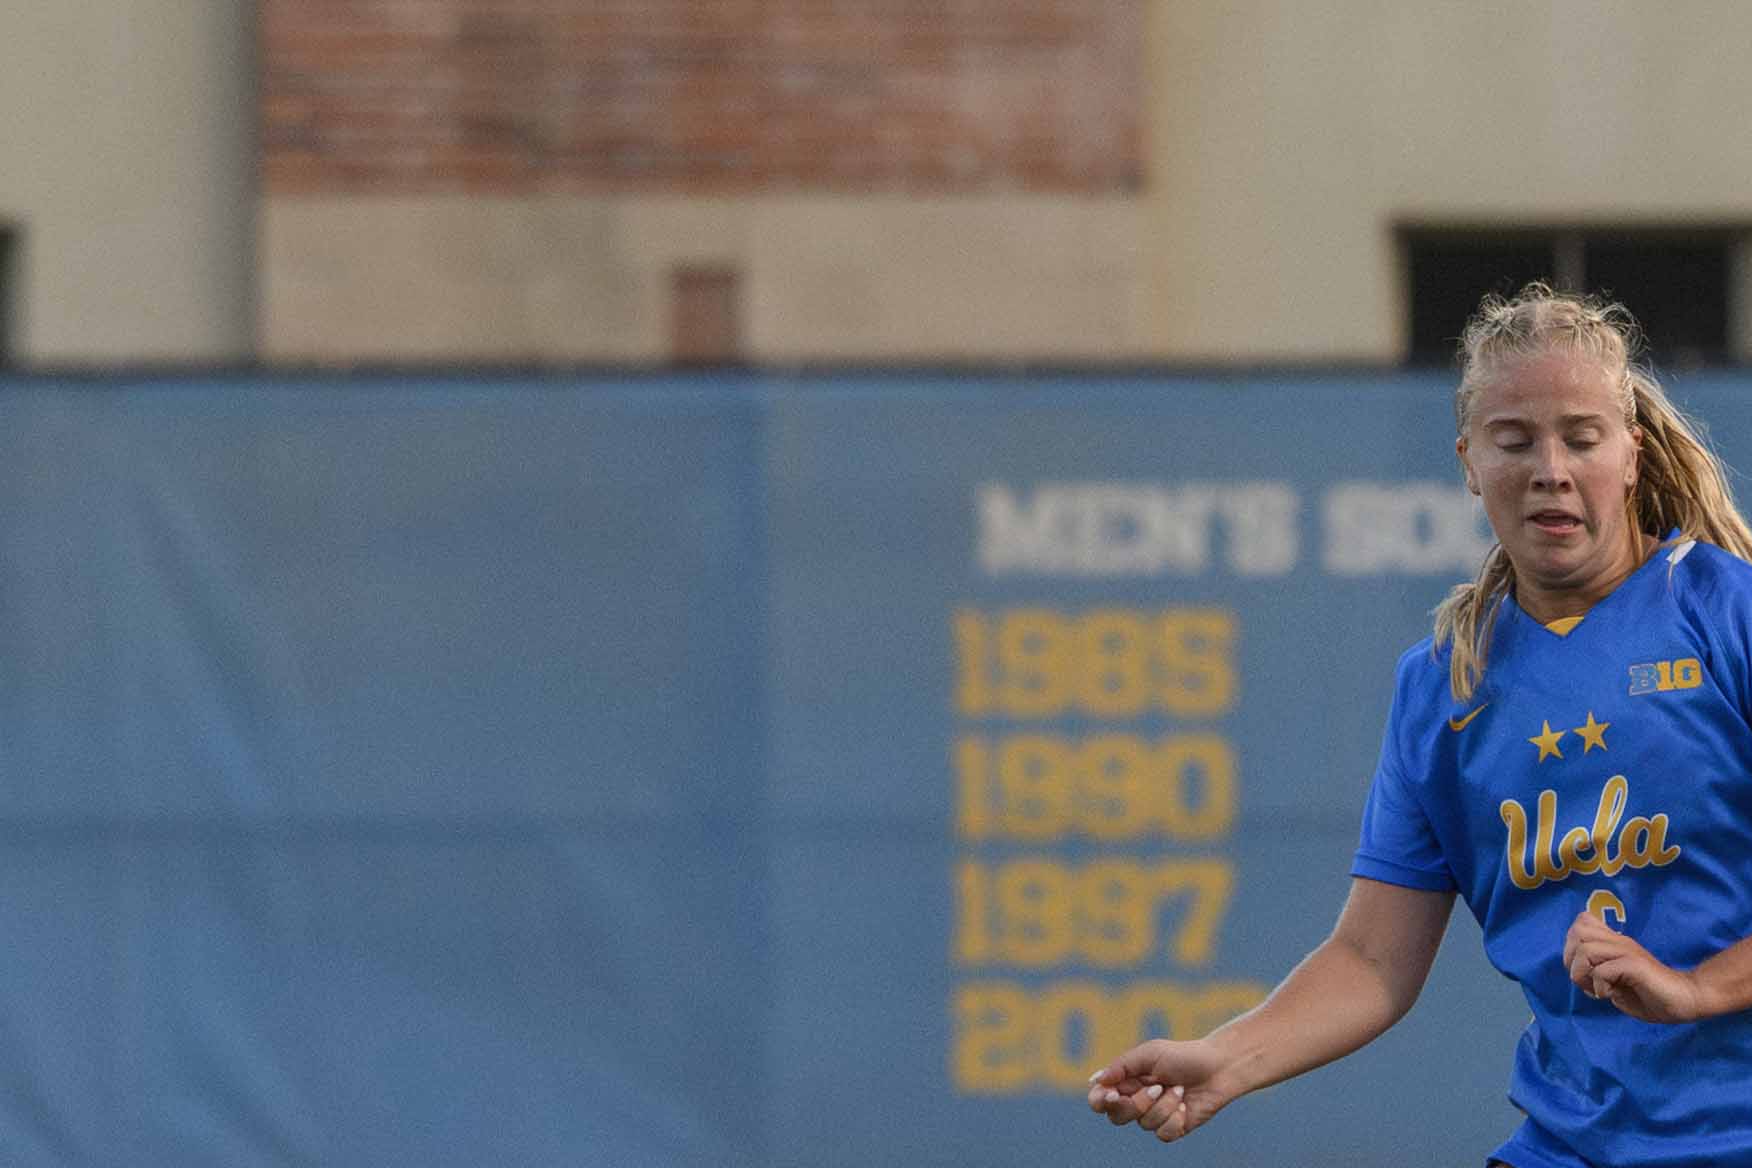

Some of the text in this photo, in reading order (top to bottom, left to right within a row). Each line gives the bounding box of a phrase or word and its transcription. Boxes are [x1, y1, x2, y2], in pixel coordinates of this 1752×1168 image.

[982, 485, 1296, 574] MEN'S
[955, 609, 1235, 716] 1985
[955, 736, 1235, 840] 1990
[955, 860, 1233, 966] 1997
